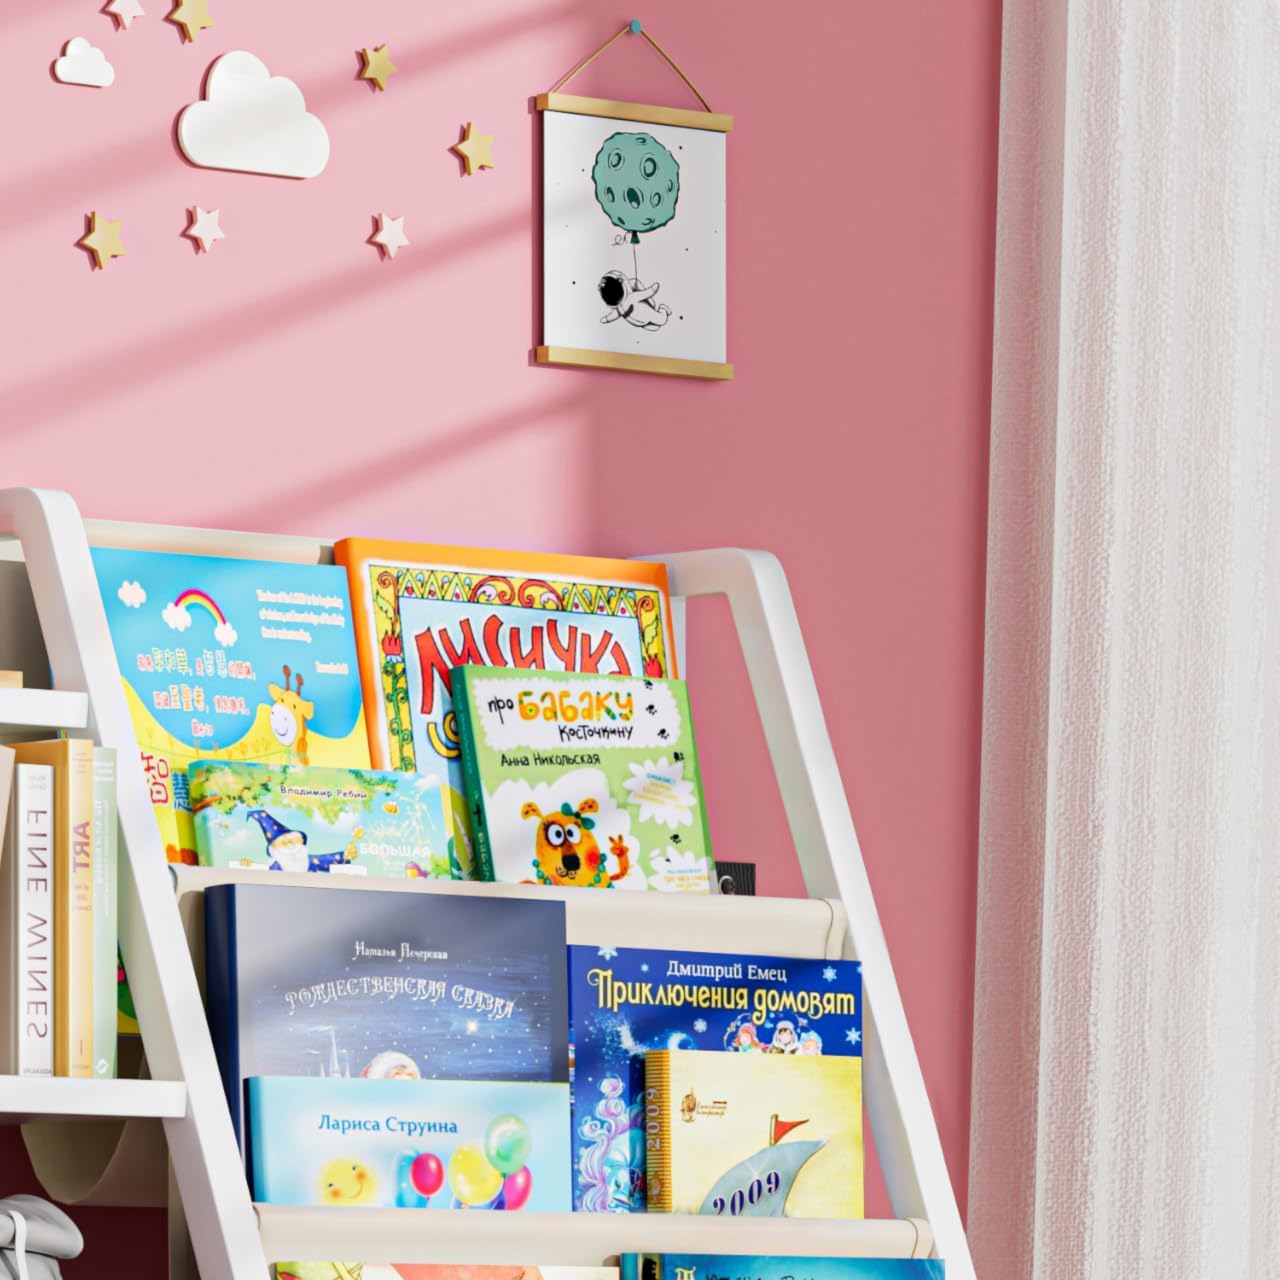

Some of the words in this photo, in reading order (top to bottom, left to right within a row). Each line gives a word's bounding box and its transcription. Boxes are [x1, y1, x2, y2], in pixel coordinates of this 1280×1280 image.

[488, 697, 514, 725] про
[501, 753, 530, 767] Анна
[534, 753, 601, 767] Никольская
[352, 940, 396, 961] Наталья
[666, 960, 743, 982] Дмитрий
[748, 965, 788, 984] Емец
[587, 968, 749, 1014] Приключения
[753, 989, 855, 1026] домовят
[319, 1115, 381, 1134] Лариса
[385, 1116, 458, 1137] Струина
[646, 1087, 661, 1151] 2009
[712, 1170, 781, 1216] 2009
